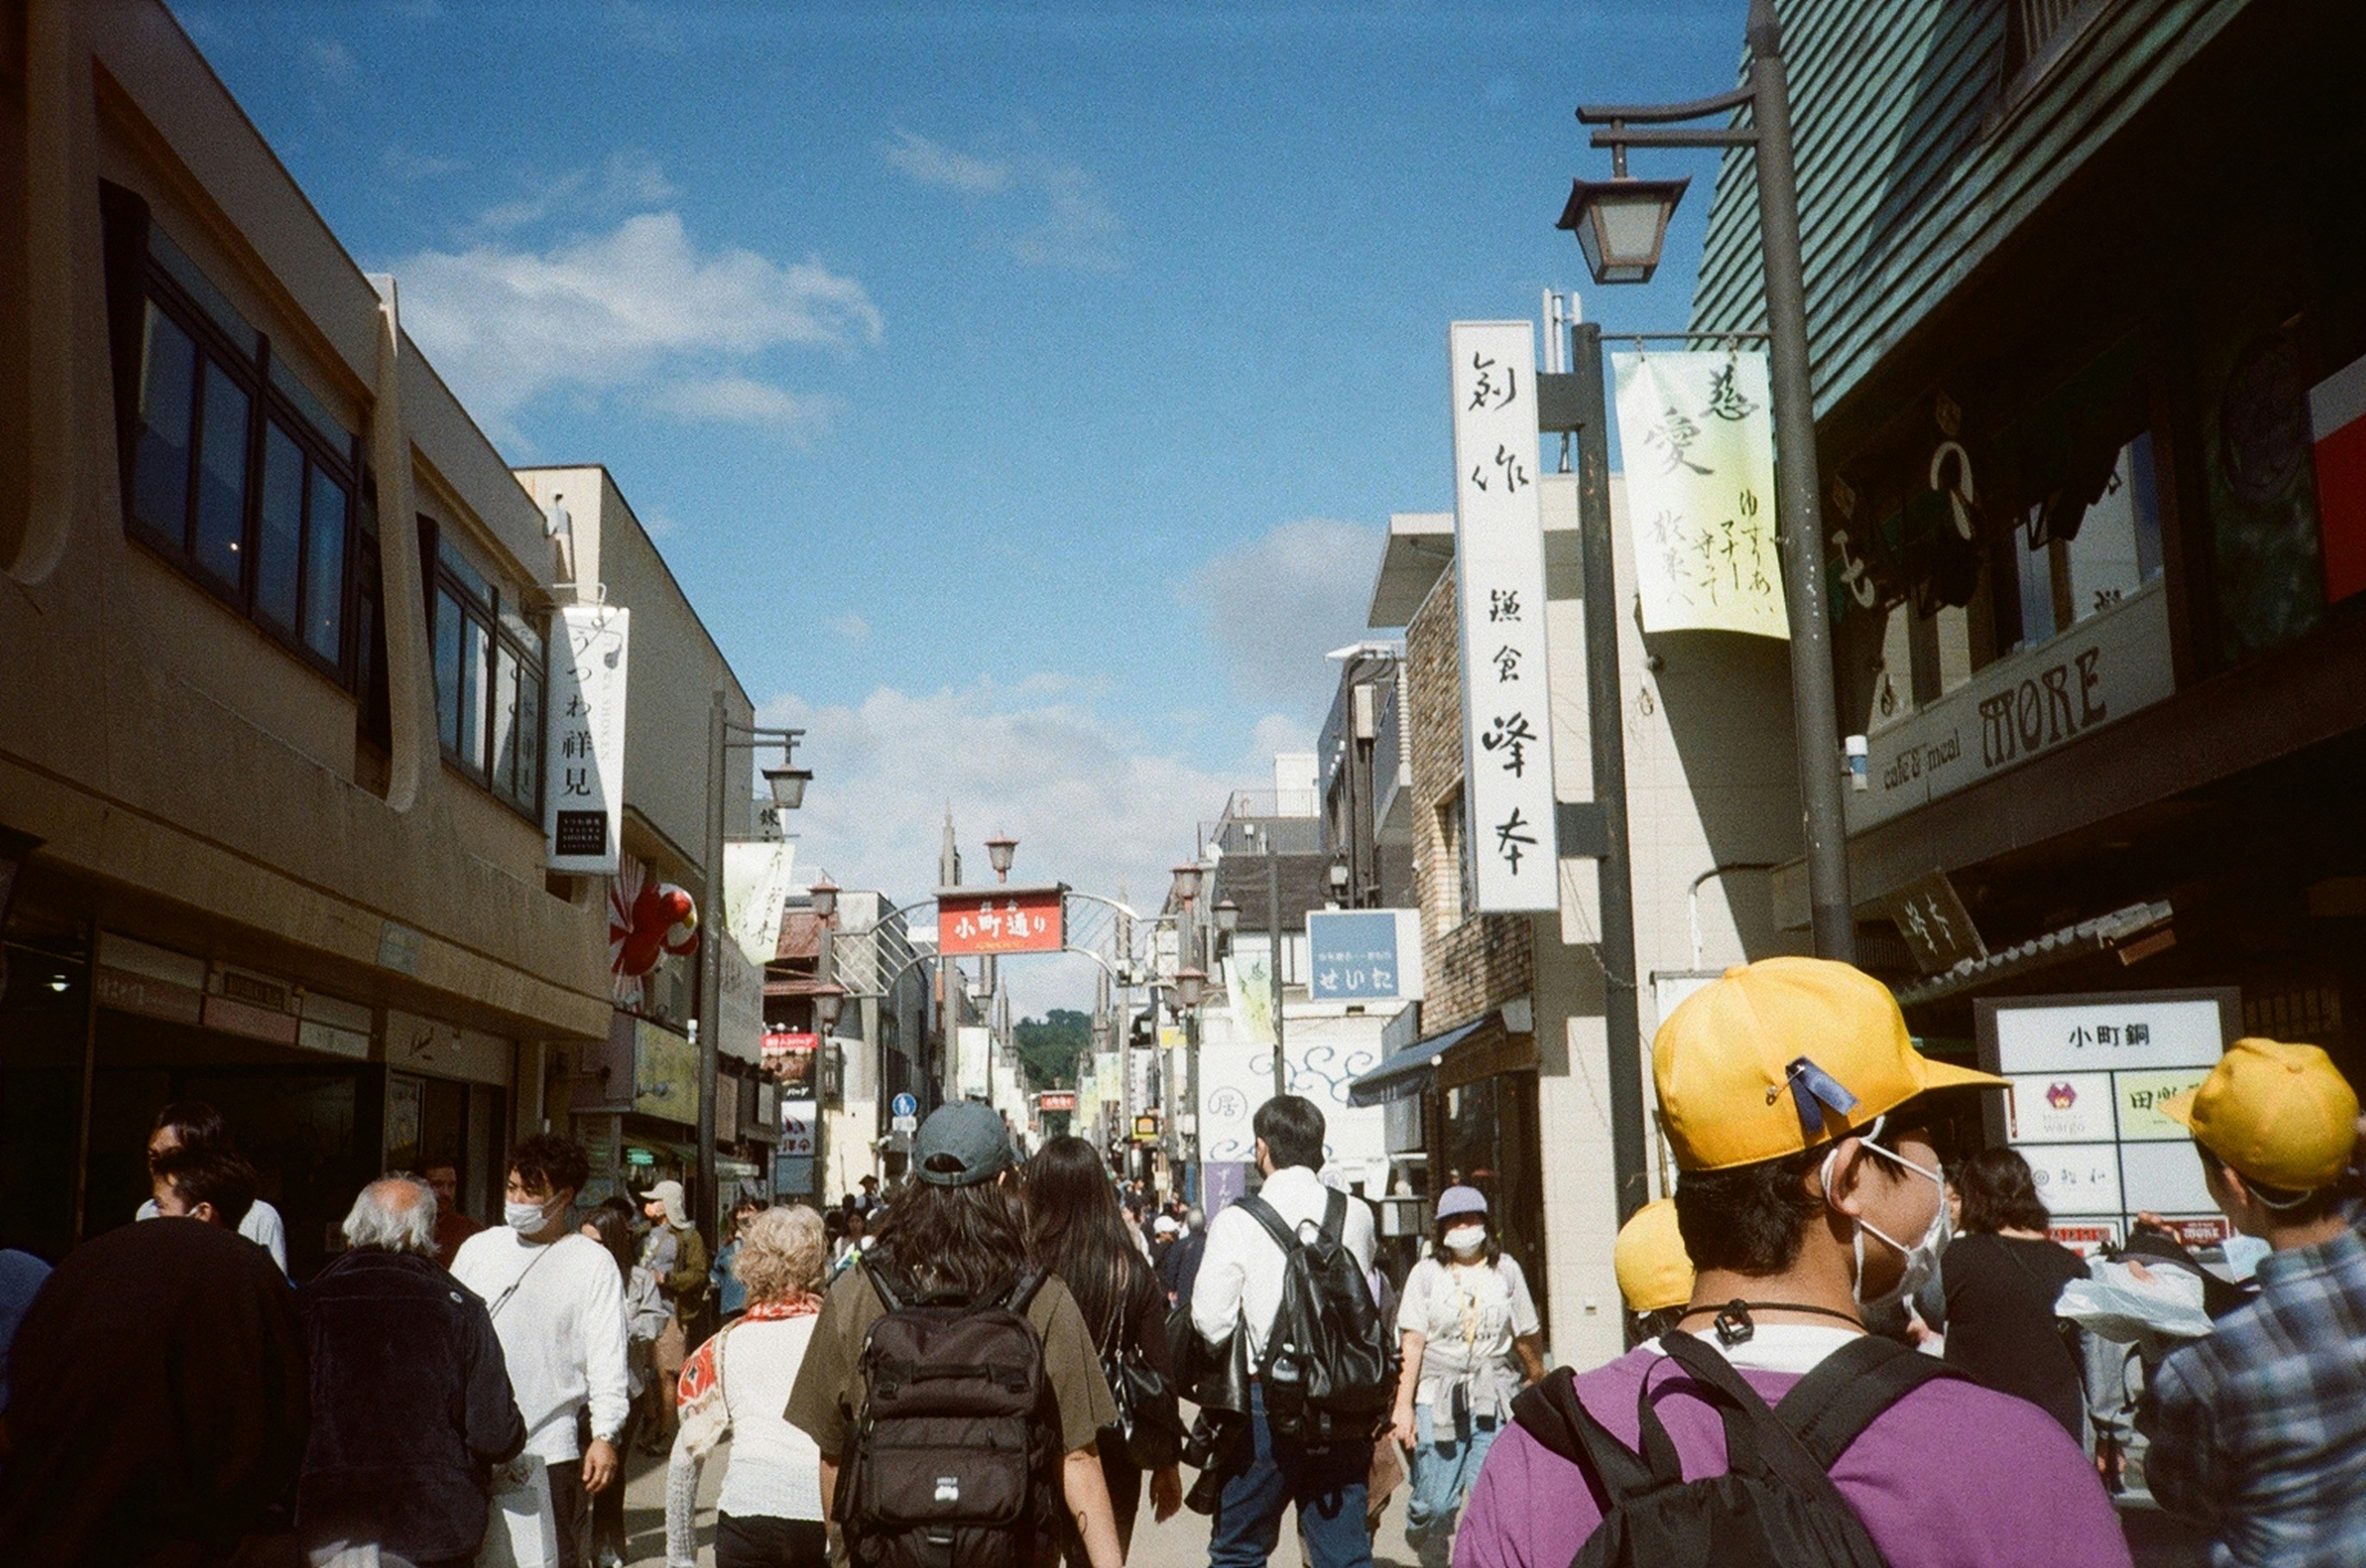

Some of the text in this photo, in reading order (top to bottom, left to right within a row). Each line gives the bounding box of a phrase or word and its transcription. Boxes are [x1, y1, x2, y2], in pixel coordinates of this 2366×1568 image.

[1978, 647, 2107, 769] MORE
[1928, 727, 1961, 772] meal
[953, 911, 1046, 940] 小町通り
